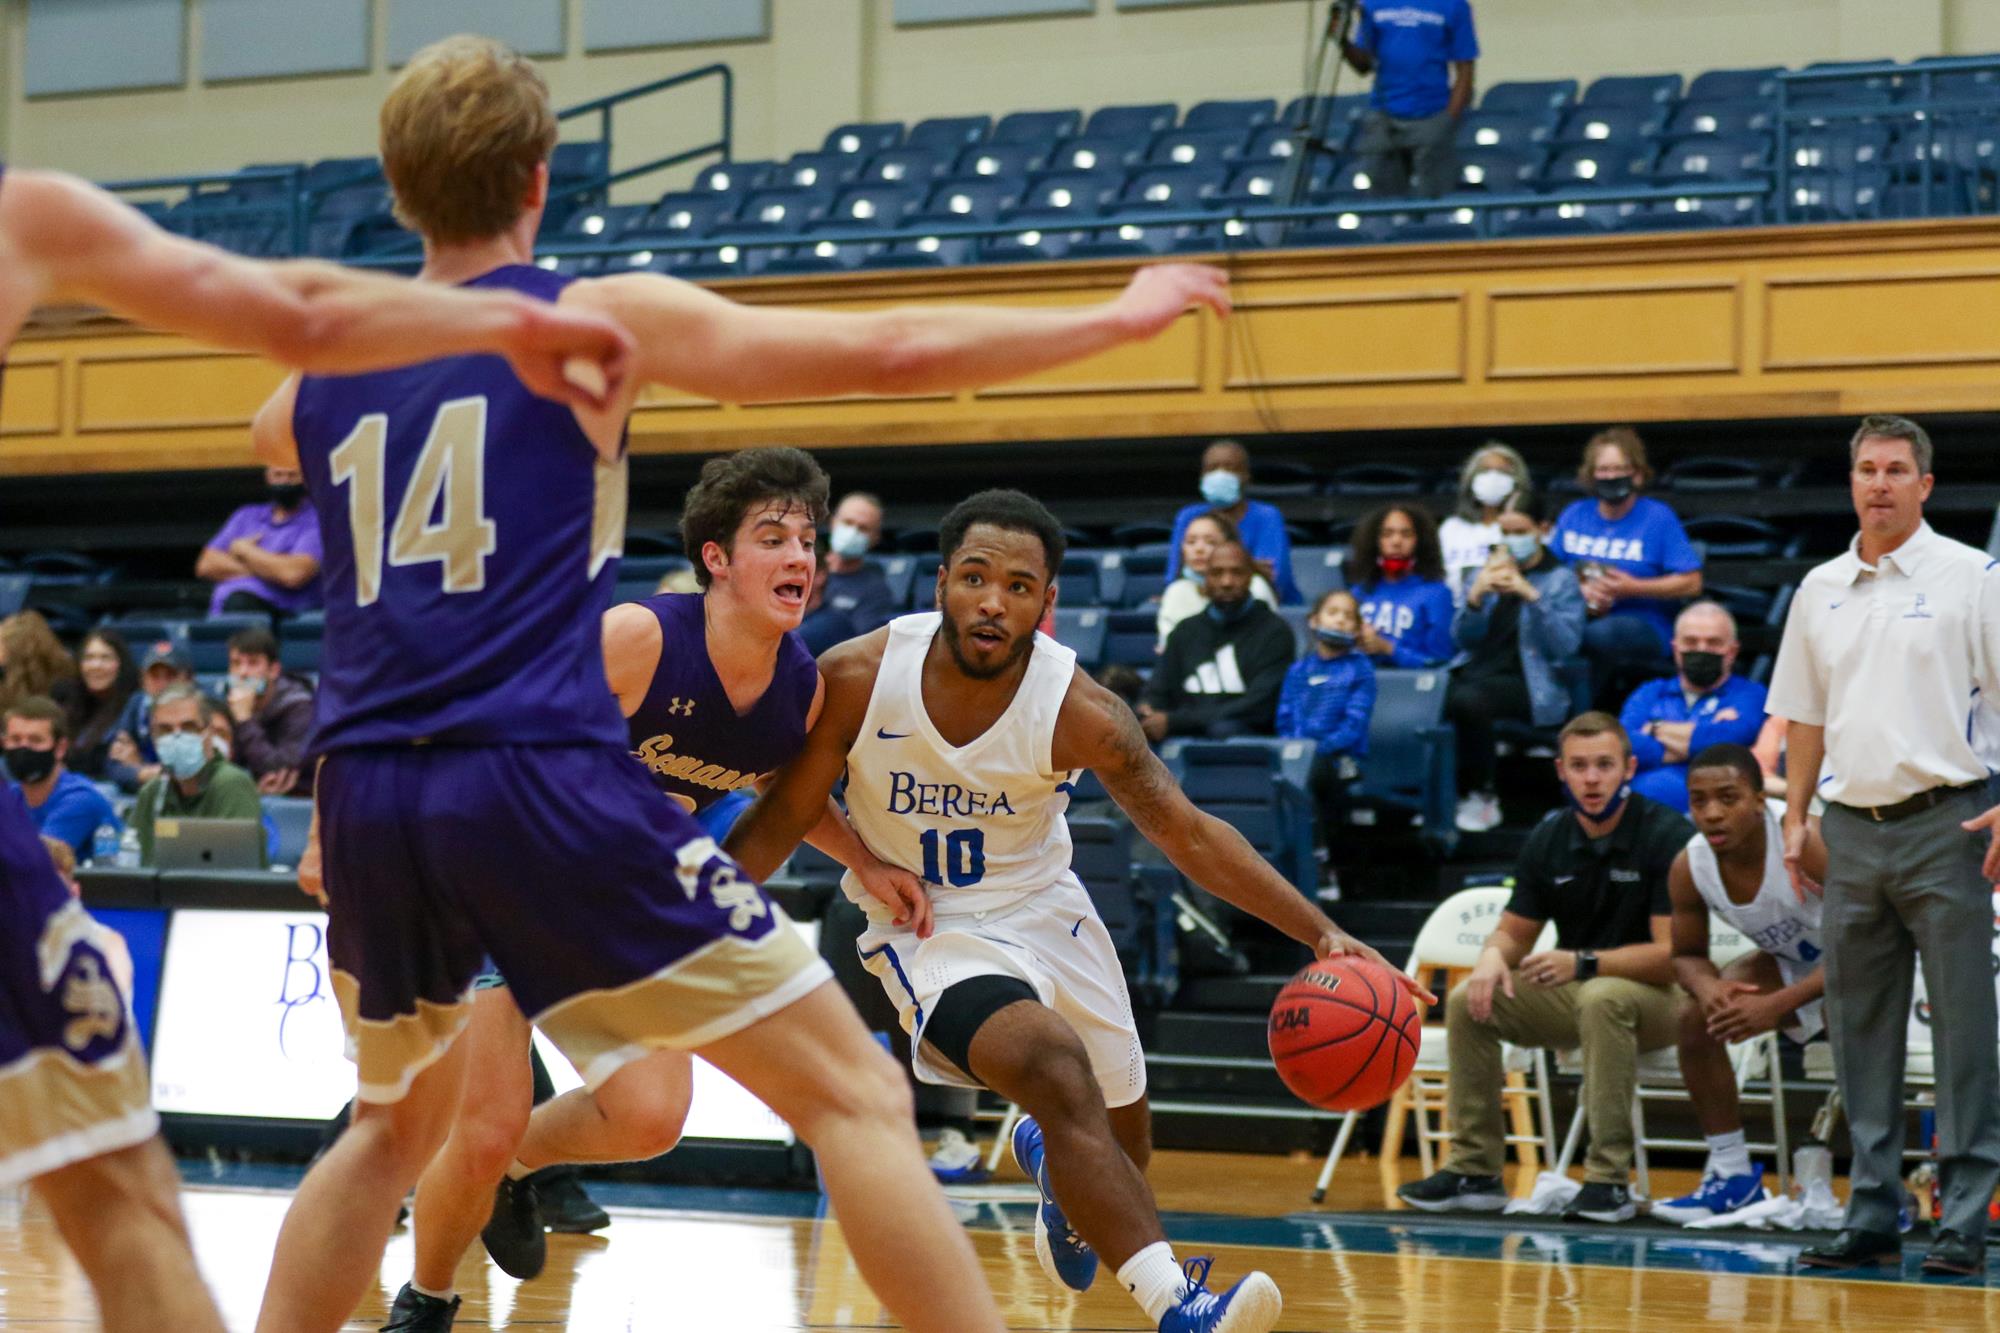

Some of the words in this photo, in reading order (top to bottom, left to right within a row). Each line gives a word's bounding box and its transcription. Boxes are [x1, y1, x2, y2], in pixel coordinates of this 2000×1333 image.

[329, 394, 496, 607] 14
[1563, 530, 1643, 561] BEREA
[887, 771, 1016, 818] BEREA
[920, 828, 986, 888] 10
